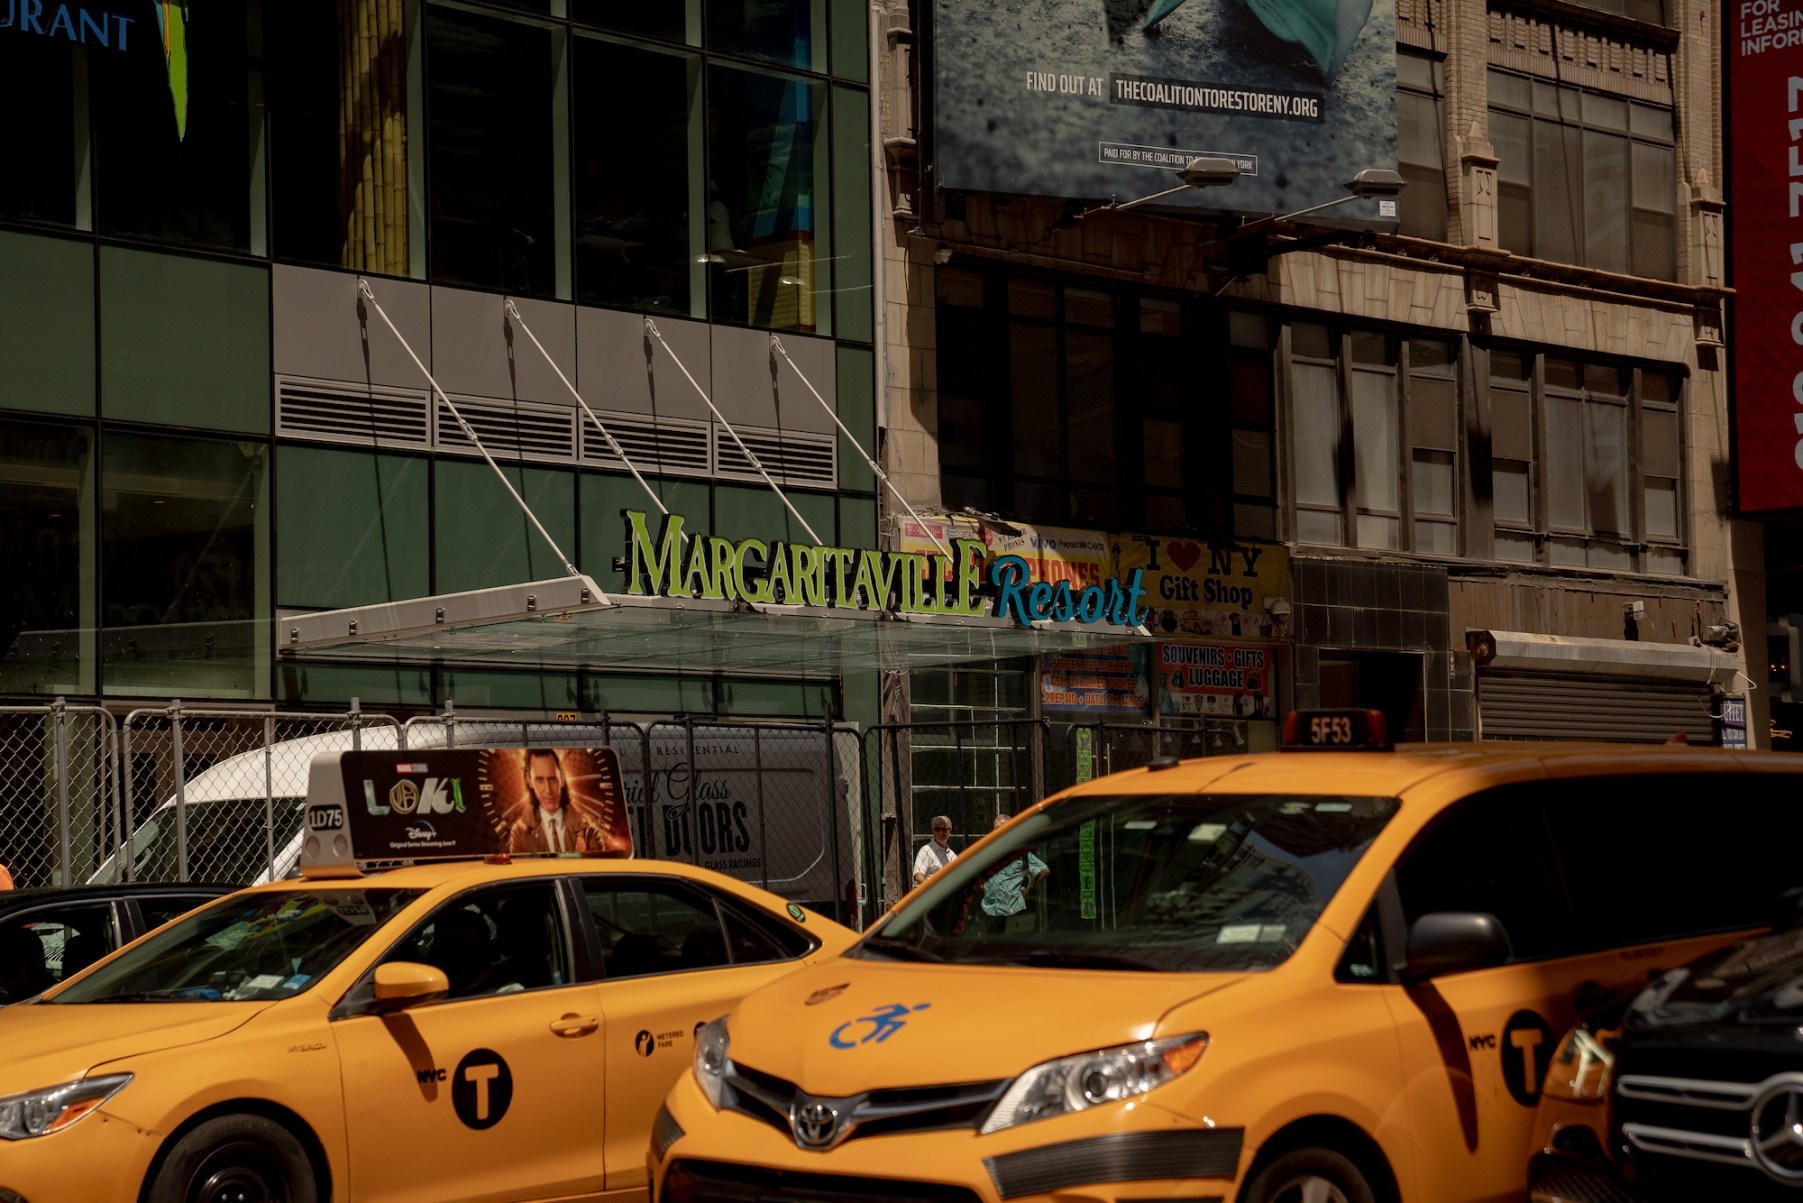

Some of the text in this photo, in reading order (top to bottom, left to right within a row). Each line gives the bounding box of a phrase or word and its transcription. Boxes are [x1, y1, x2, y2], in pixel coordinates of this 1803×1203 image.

[1740, 0, 1780, 19] FOR
[1741, 28, 1803, 57] INFOR
[1026, 71, 1318, 118] FIND OUT AT THECOALITIONTORESTORENY.ORG
[1104, 147, 1119, 158] PAID
[1120, 149, 1131, 159] FOR
[1132, 150, 1140, 159] BY
[1142, 151, 1153, 161] THE
[1154, 152, 1184, 164] COALITION
[1236, 160, 1252, 170] YORK
[1147, 540, 1161, 570] I
[991, 555, 1149, 627] Resort
[1160, 575, 1252, 610] Gift Shop
[1052, 658, 1082, 671] SCREEN
[1163, 644, 1264, 669] SOUVENIRS GIFTS
[1108, 677, 1137, 690] PHONES
[1188, 667, 1243, 688] LUGGAGE
[1045, 692, 1077, 705] PREPAID
[1085, 693, 1105, 706] DATA
[1723, 704, 1744, 722] UFFET
[1311, 716, 1352, 744] 5F53
[657, 745, 740, 756] RESIENTIAL
[363, 777, 466, 816] LOKI
[309, 809, 343, 828] 1D75
[705, 860, 726, 870] GLASS
[657, 1030, 684, 1040] METERED
[1469, 1027, 1544, 1096] NYC T
[417, 1062, 500, 1121] NYC T
